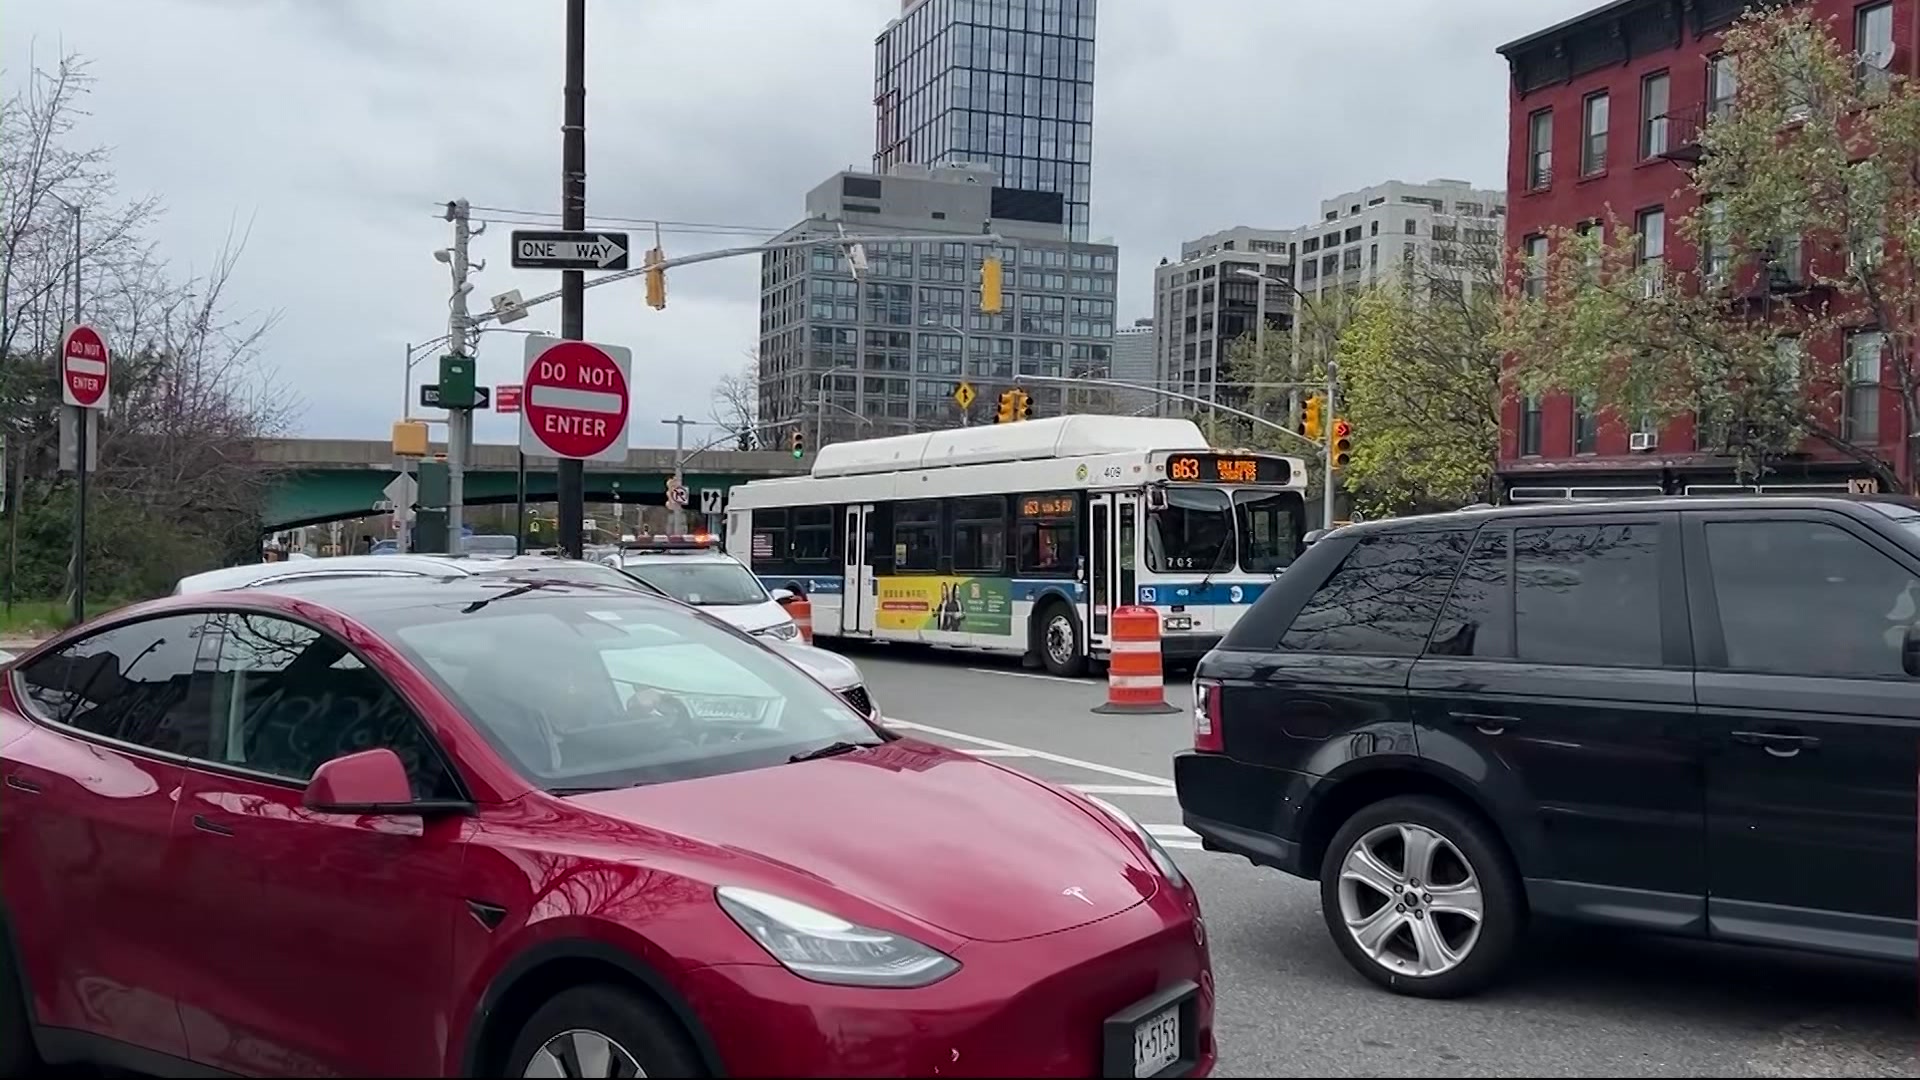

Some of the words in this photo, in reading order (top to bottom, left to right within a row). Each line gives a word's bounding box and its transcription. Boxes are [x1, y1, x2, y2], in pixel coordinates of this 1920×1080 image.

[522, 242, 557, 258] ONE
[576, 244, 613, 259] WAY
[71, 340, 83, 354] DO
[84, 343, 100, 356] NOT
[73, 376, 98, 391] ENTER
[541, 361, 566, 381] DO
[579, 365, 616, 387] NOT
[545, 414, 606, 438] ENTER
[1172, 458, 1199, 479] B63
